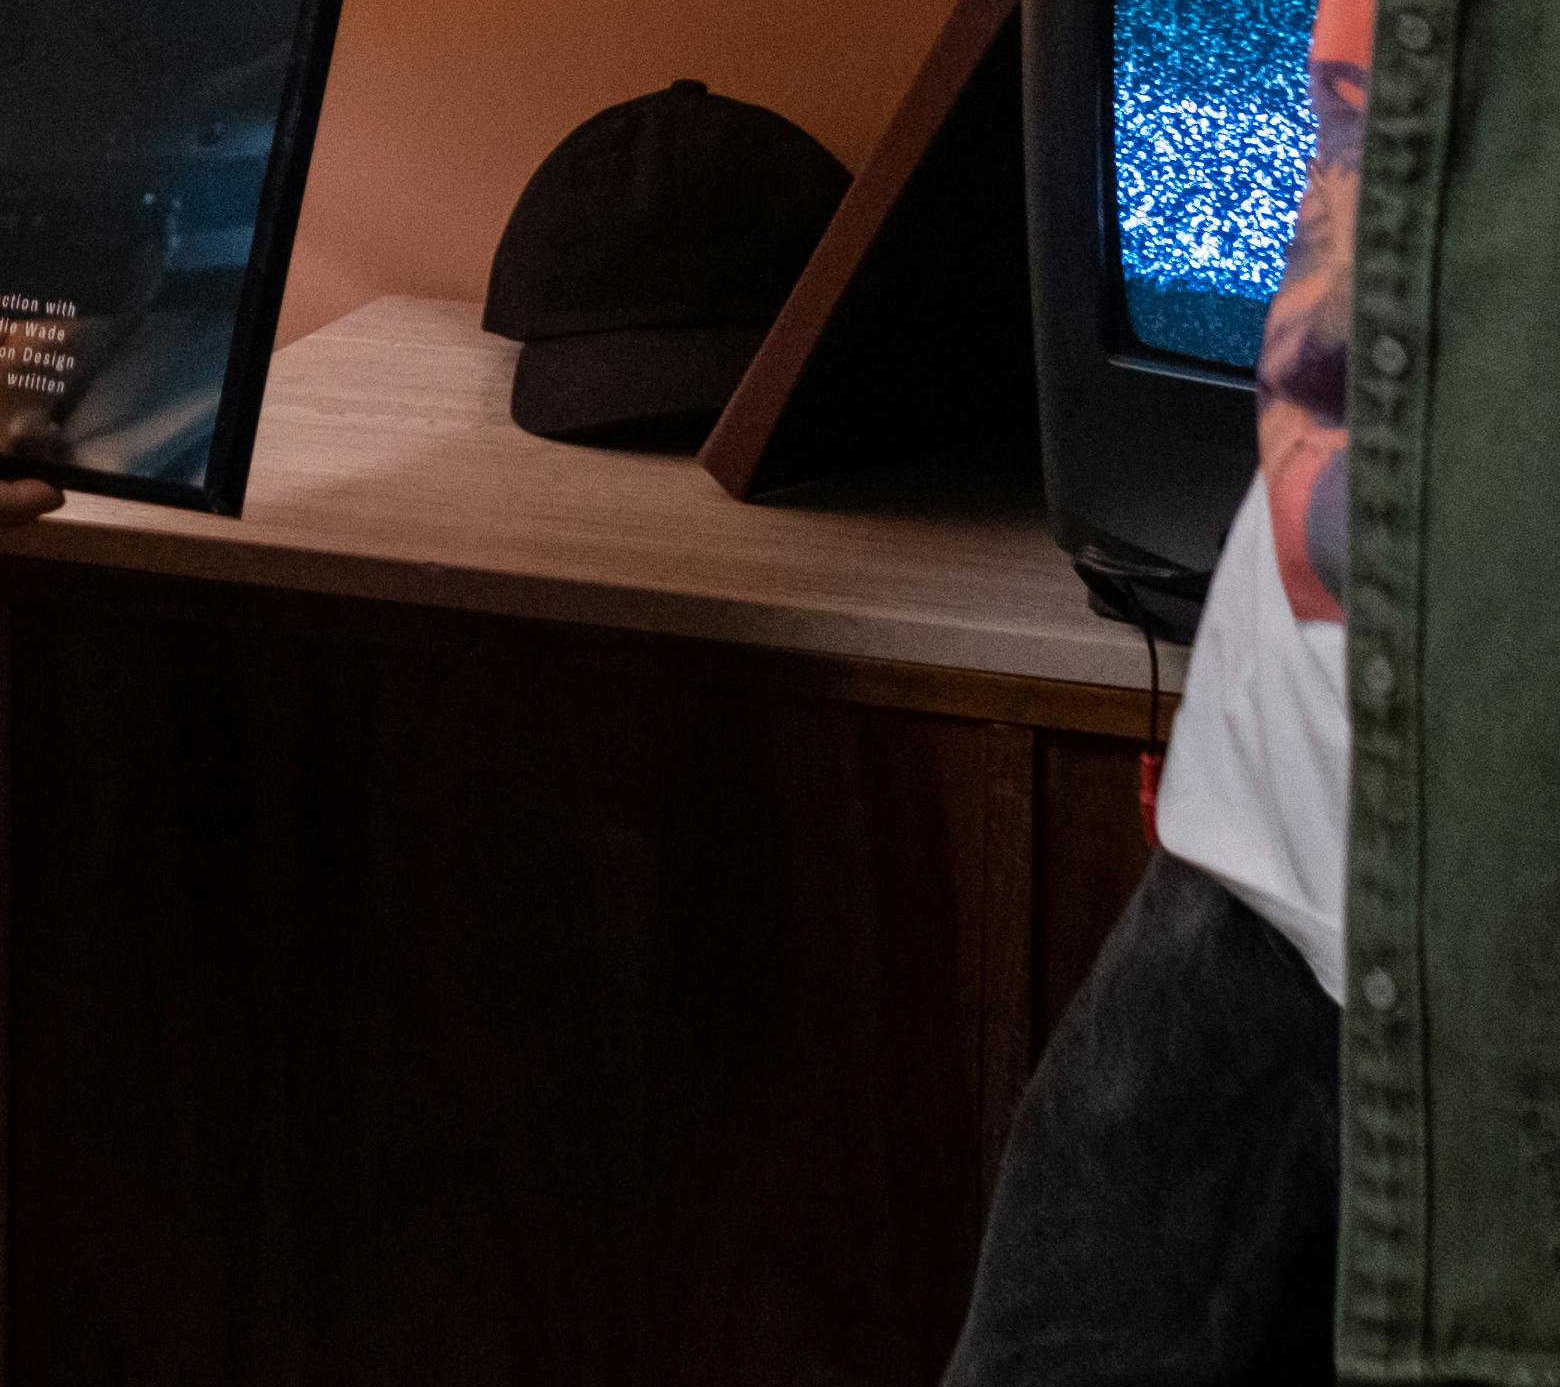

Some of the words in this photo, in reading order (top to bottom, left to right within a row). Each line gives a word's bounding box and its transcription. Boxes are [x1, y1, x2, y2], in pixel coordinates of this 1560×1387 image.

[45, 299, 77, 318] with
[25, 321, 65, 342] Wade
[22, 346, 75, 372] Design
